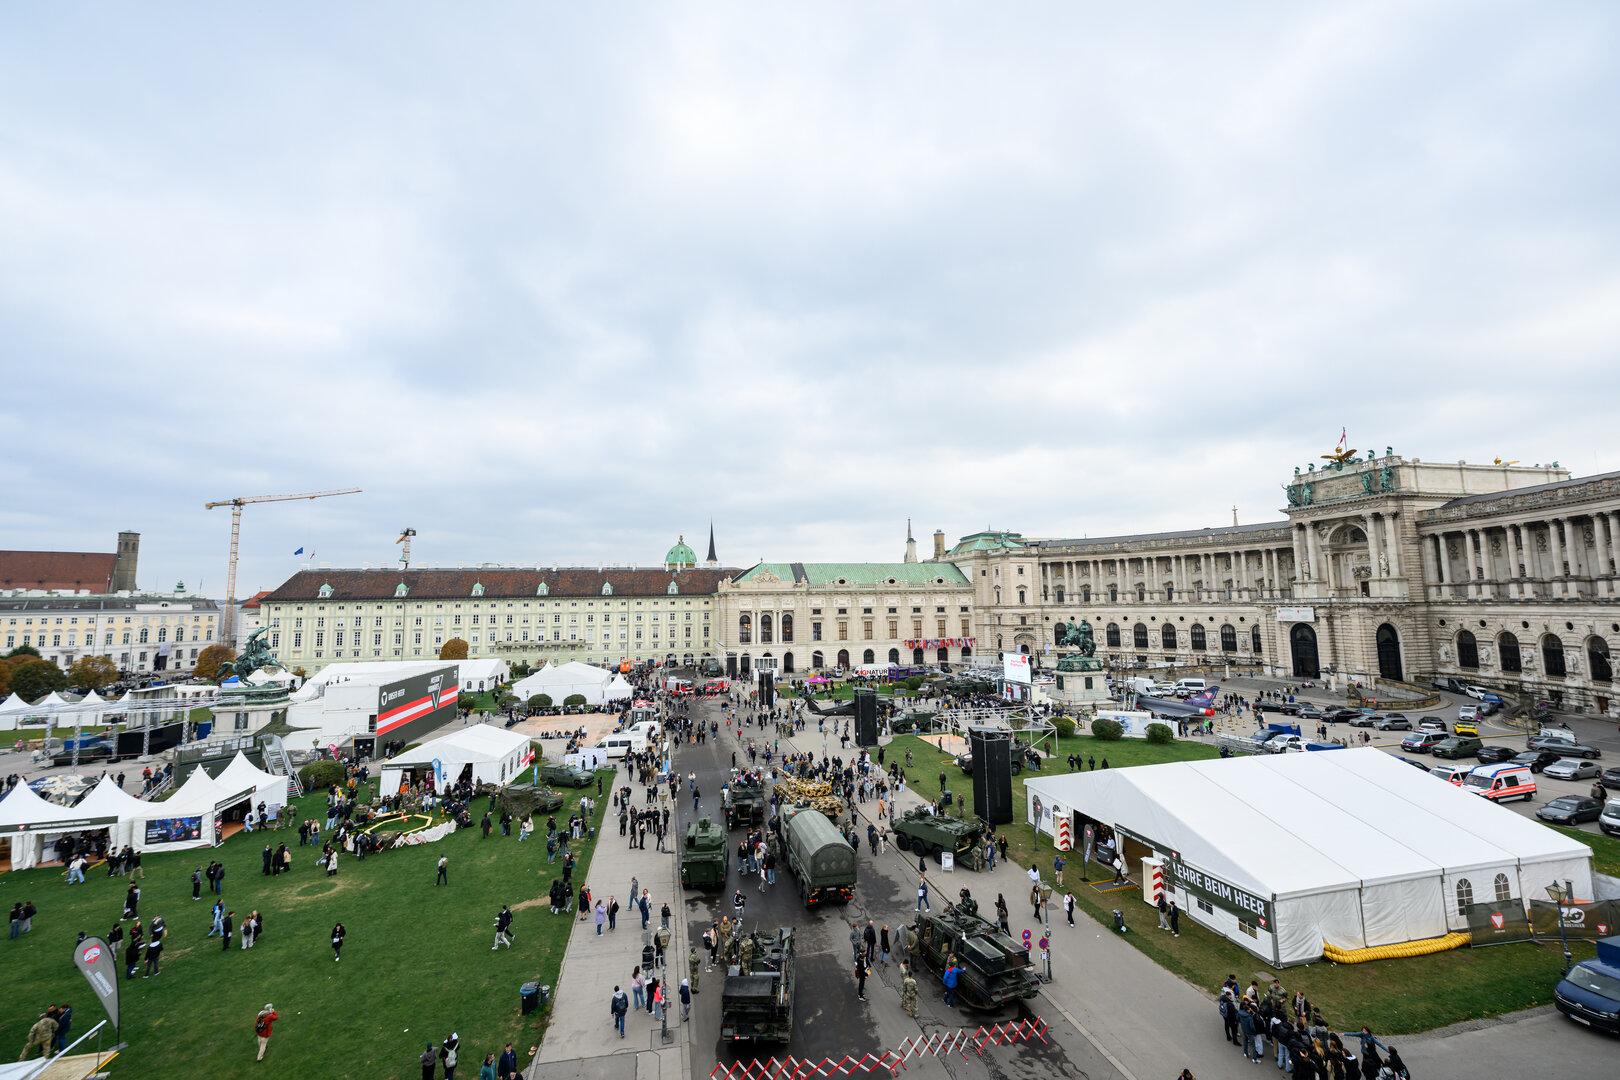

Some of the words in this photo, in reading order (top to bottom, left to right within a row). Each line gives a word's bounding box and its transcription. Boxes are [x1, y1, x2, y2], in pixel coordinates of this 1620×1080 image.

[1172, 861, 1203, 888] LEHRE
[1204, 876, 1232, 902] BEIM
[1234, 889, 1266, 917] HEER
